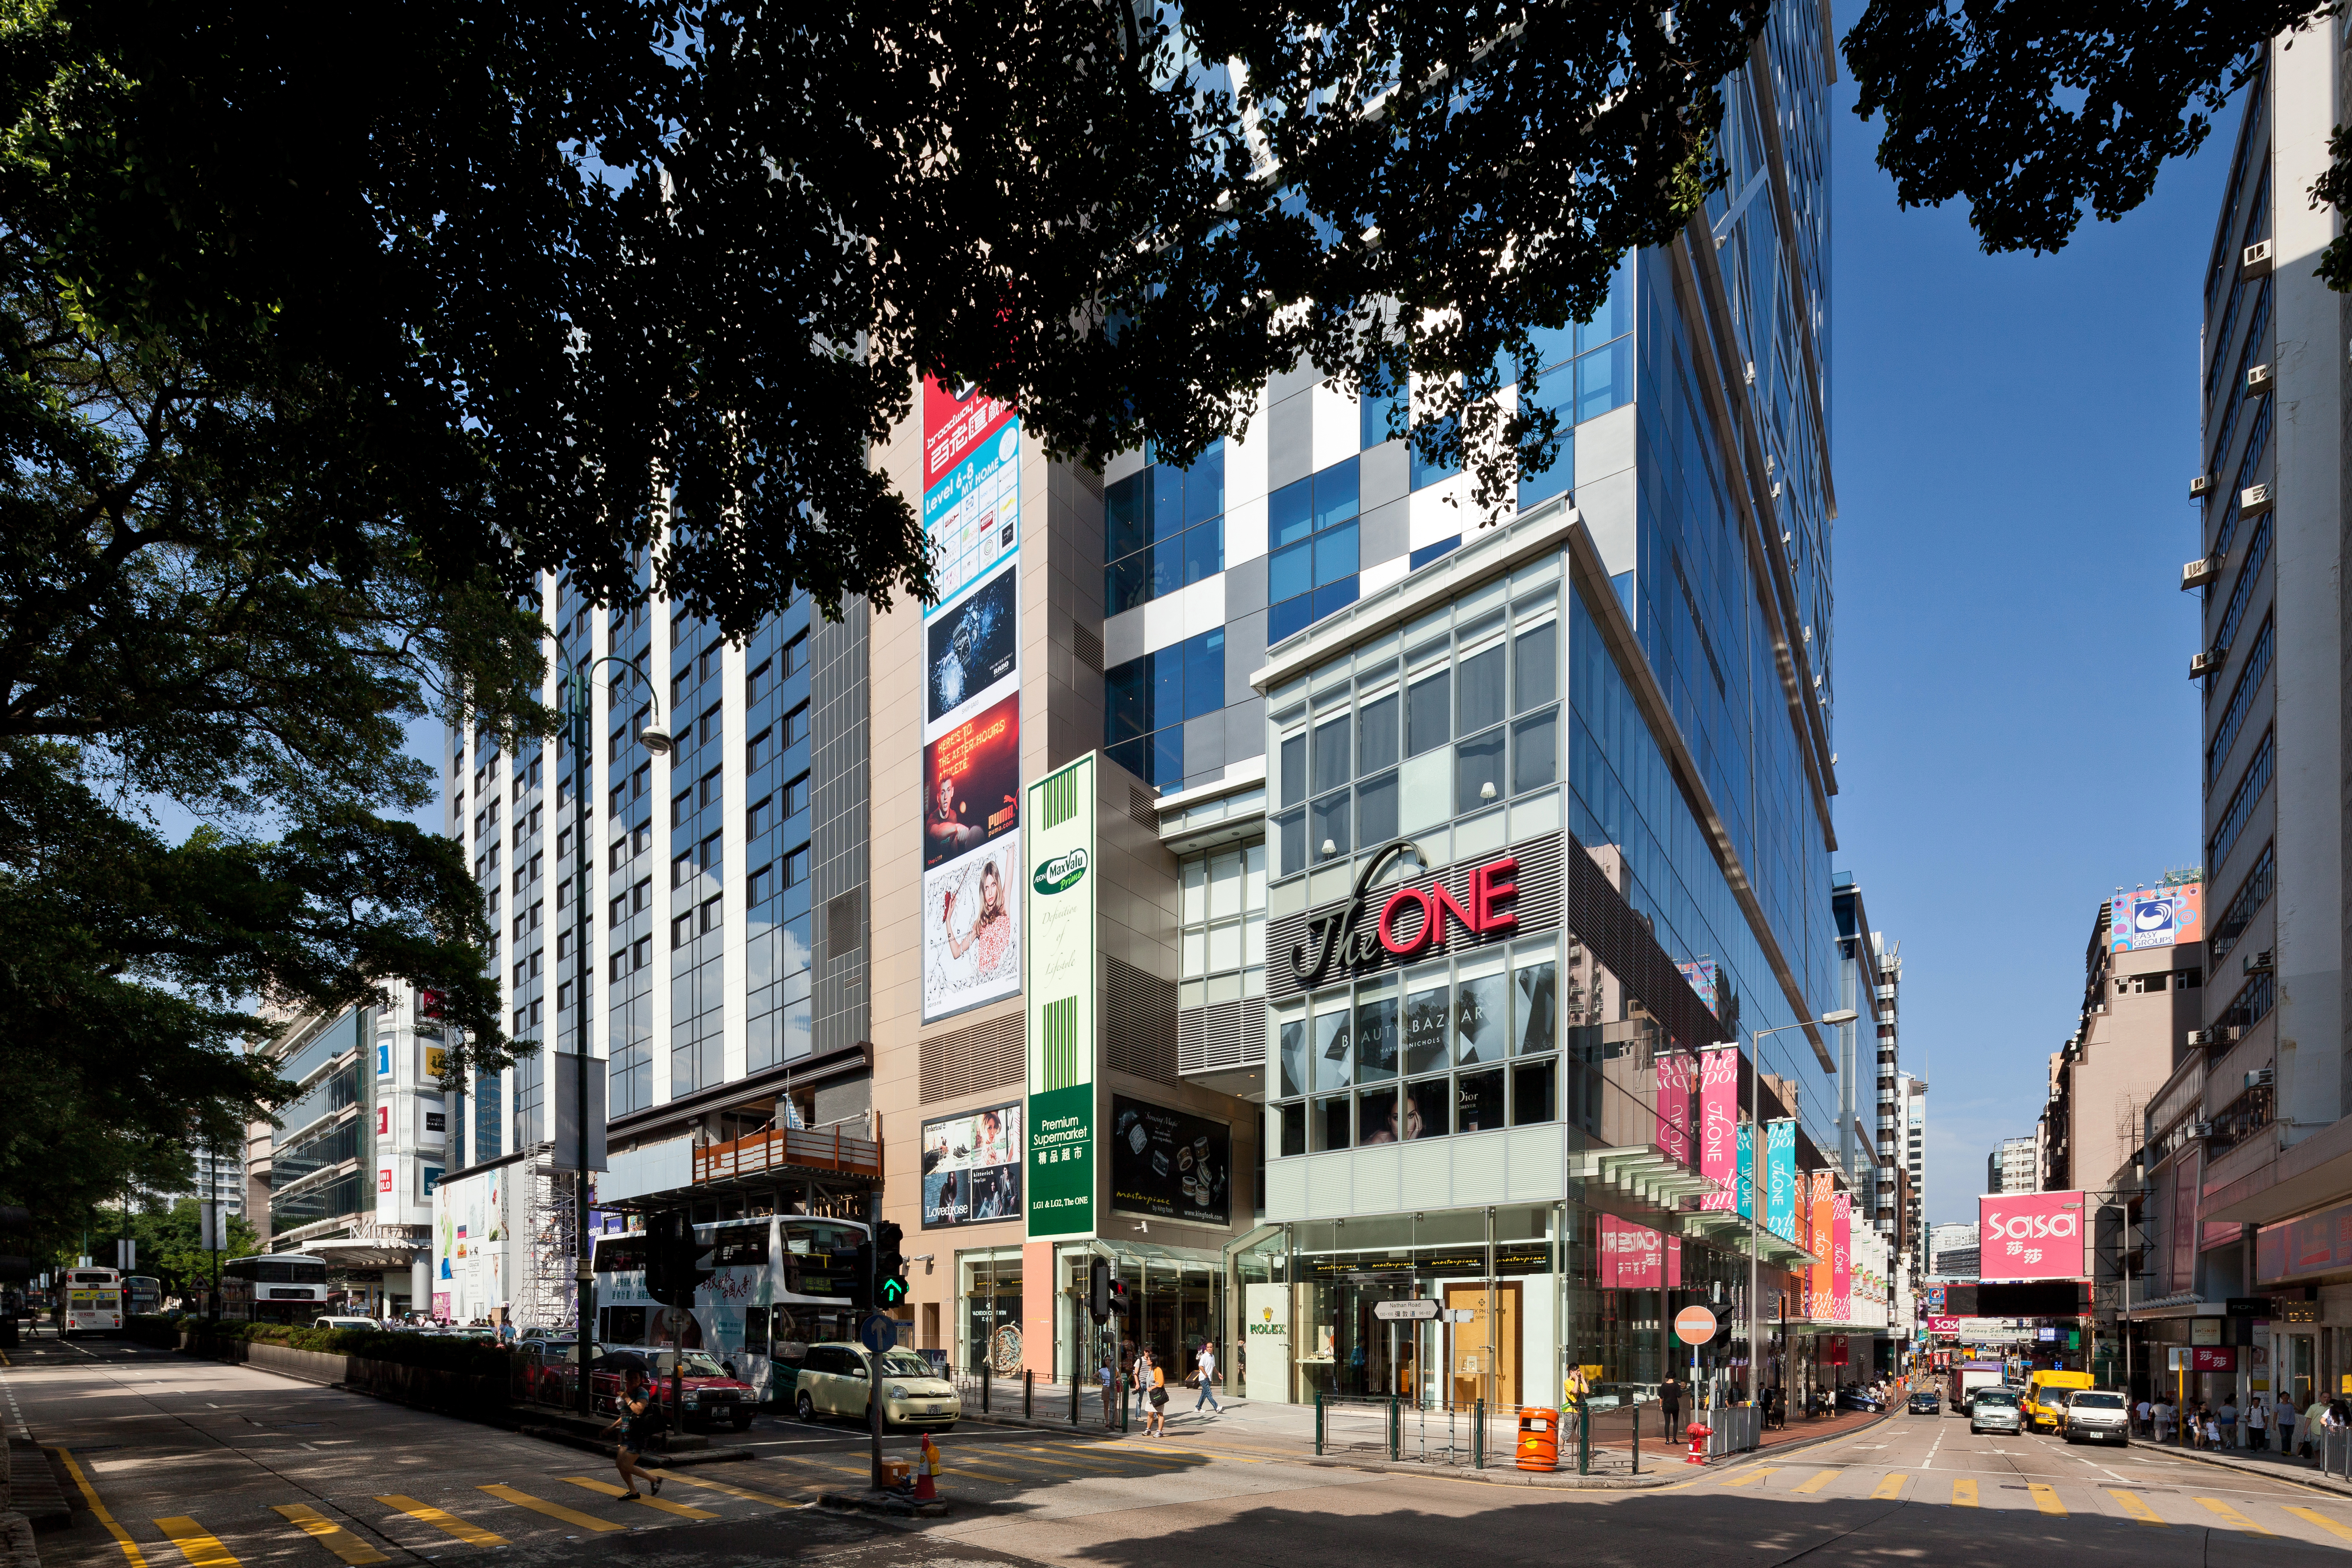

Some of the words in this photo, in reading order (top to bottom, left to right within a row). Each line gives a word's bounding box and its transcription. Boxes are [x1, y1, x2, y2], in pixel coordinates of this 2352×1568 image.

[927, 401, 973, 450] broadway
[962, 478, 973, 497] MY
[975, 457, 999, 485] HOME
[926, 479, 953, 515] Level
[956, 462, 974, 489] 6-8
[989, 659, 1003, 670] UNLIMITED
[1004, 652, 1013, 661] SPIRIT
[994, 661, 1009, 675] RADO
[962, 705, 970, 714] SHOP
[939, 730, 960, 754] HERE'S
[963, 723, 972, 738] TO
[939, 756, 951, 769] THE
[952, 739, 974, 761] AFTER
[976, 719, 1005, 746] HOURS
[939, 760, 967, 782] ATHLETE
[988, 805, 1014, 829] PUMA
[988, 819, 1013, 838] puma.com
[1050, 850, 1082, 878] MaxValu
[1060, 870, 1082, 890] Prime
[1288, 839, 1428, 978] The
[1378, 857, 1519, 955] ONE
[1042, 900, 1078, 937] Definition
[1051, 920, 1069, 956] of
[2134, 931, 2157, 940] EASY
[2134, 936, 2173, 947] GROUPS
[1044, 950, 1076, 988] Lifestyle
[1342, 1025, 1399, 1047] BAUT
[1413, 1006, 1483, 1033] BAZAR
[1409, 1037, 1440, 1048] NICHOLS
[1459, 1091, 1478, 1103] Dior
[926, 1124, 942, 1133] Timberland
[1042, 1116, 1079, 1131] Premium
[1033, 1127, 1088, 1147] Supermarket
[1707, 1127, 1722, 1161] ONE
[1039, 1146, 1082, 1164] 精品超市
[380, 1172, 389, 1181] UNI
[380, 1182, 390, 1191] QLO
[1772, 1181, 1783, 1205] ONE
[1050, 1199, 1063, 1209] LG2,
[1064, 1198, 1074, 1206] The
[1075, 1197, 1088, 1205] ONE
[1116, 1191, 1170, 1205] masterpiece
[926, 1203, 968, 1218] Lovedrose
[1184, 1210, 1222, 1221] www.kingfook.com
[2006, 1241, 2042, 1264] 莎莎
[1835, 1256, 1843, 1274] ONE
[1250, 1324, 1286, 1335] ROLEX
[2200, 1351, 2227, 1367] 莎莎
